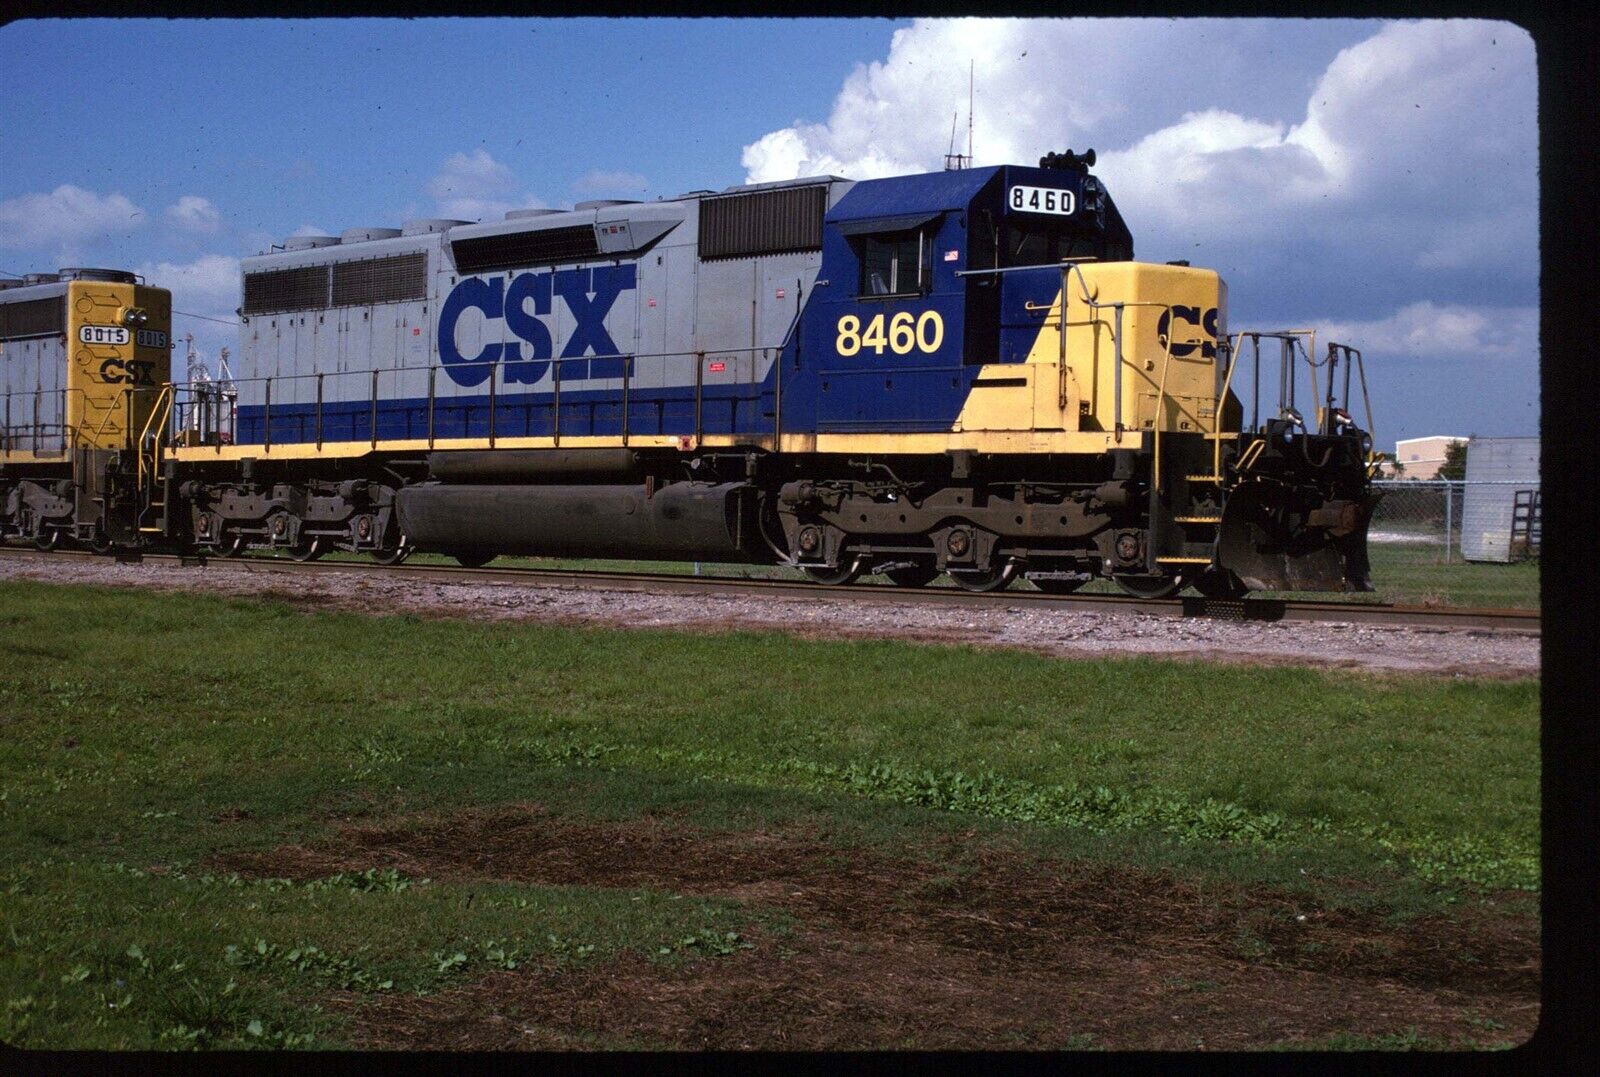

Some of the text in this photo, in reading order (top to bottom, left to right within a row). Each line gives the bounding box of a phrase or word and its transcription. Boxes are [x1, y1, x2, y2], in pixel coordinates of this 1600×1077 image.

[1013, 188, 1071, 212] 8460
[84, 328, 124, 342] 8015
[438, 263, 637, 387] CSX
[836, 309, 944, 357] 8460
[100, 358, 156, 386] CSX
